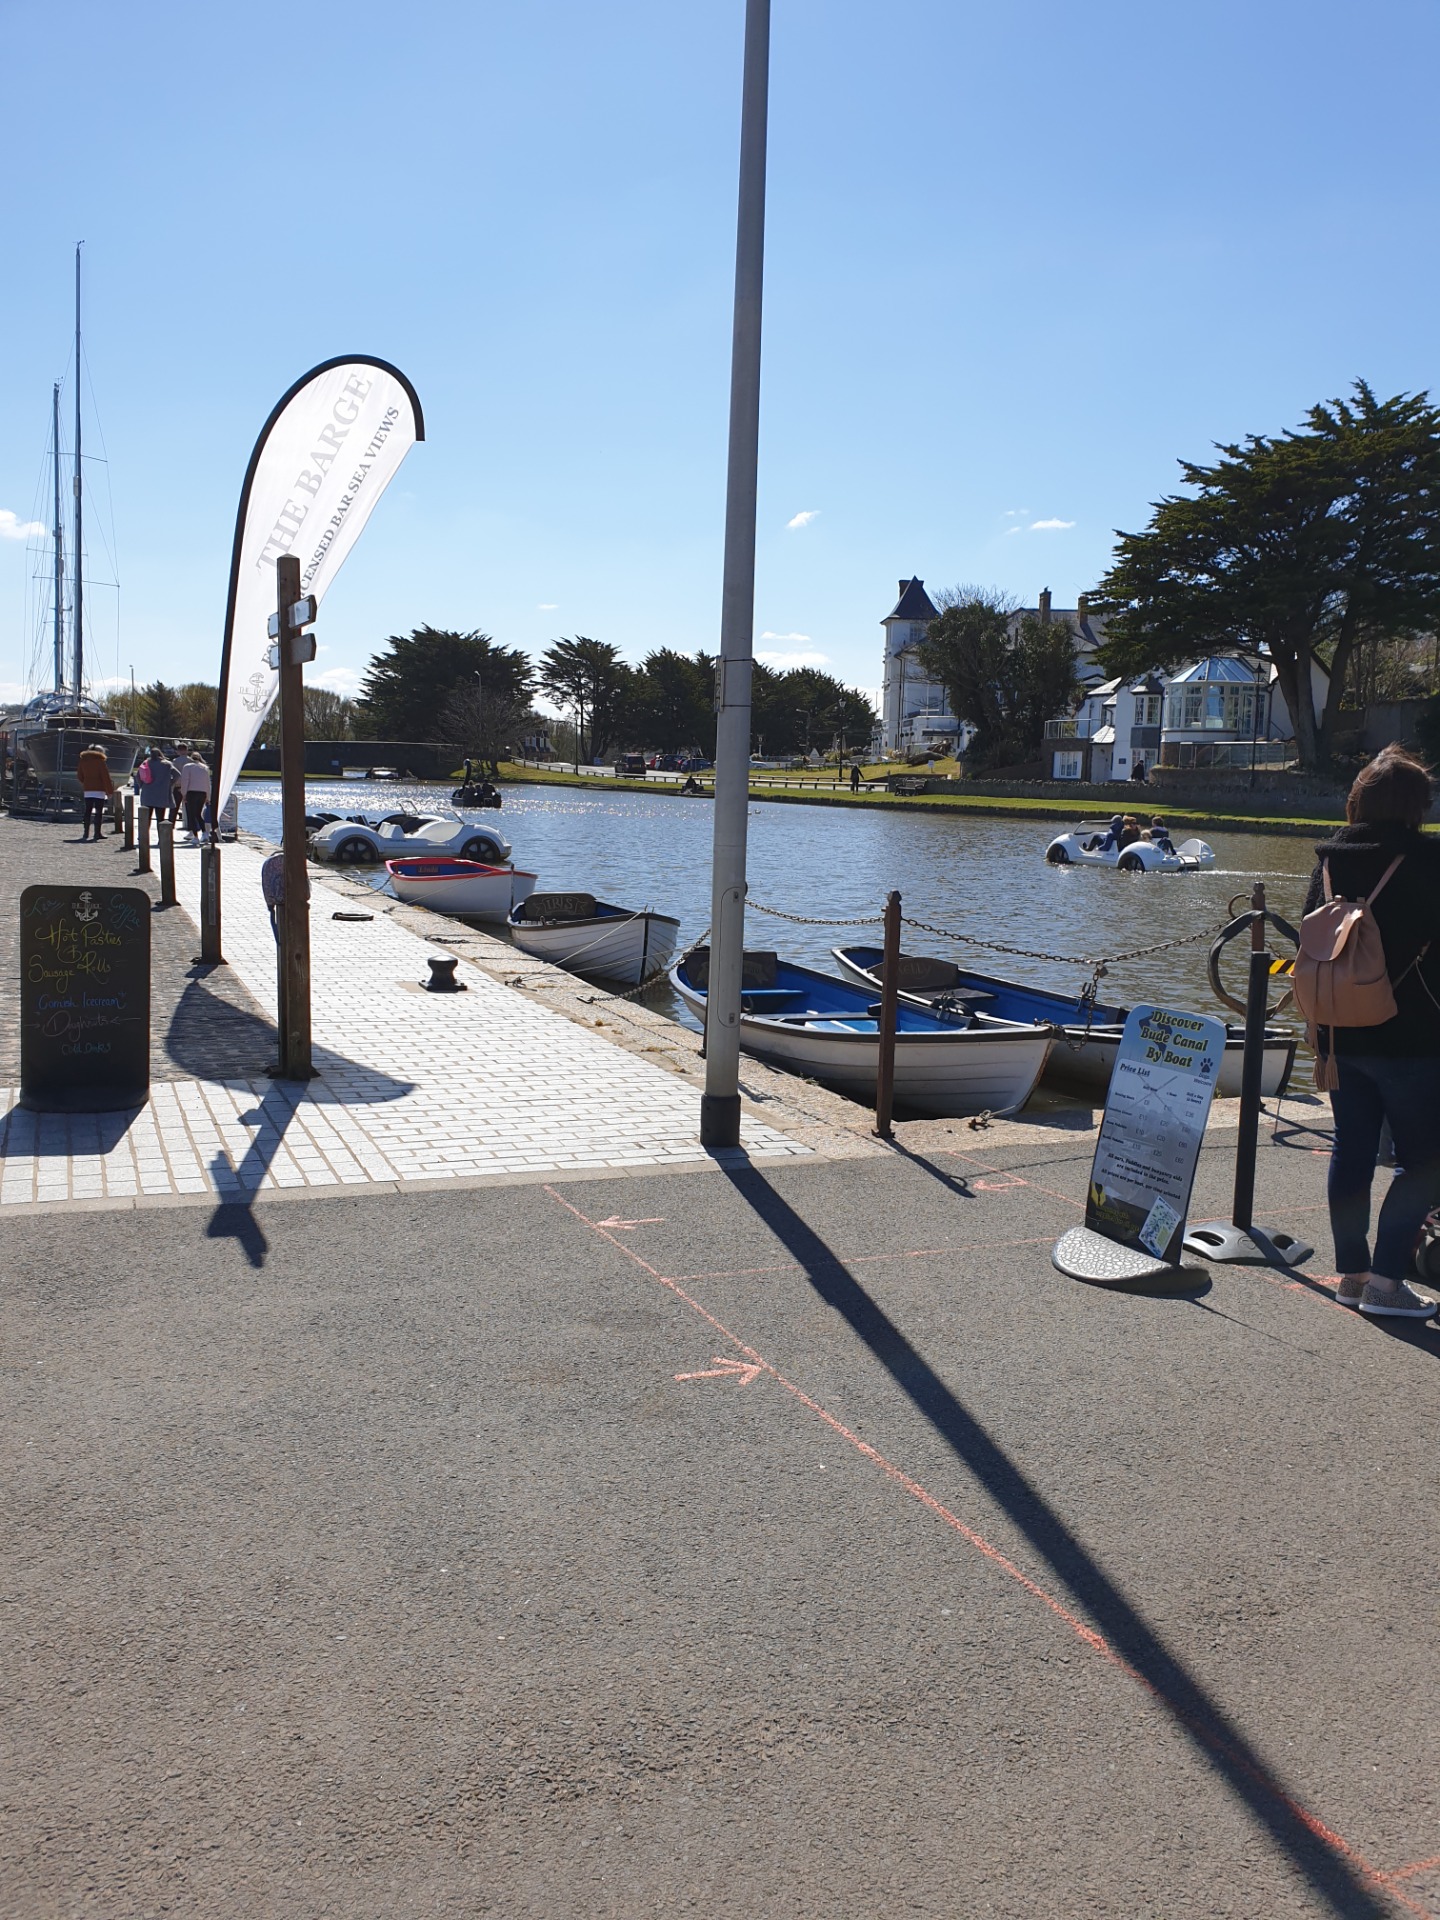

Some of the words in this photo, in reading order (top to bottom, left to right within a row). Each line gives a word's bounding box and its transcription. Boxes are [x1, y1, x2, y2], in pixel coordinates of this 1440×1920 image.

[256, 498, 309, 576] THE
[294, 373, 373, 499] BARGE
[331, 494, 354, 527] BAR
[348, 463, 371, 494] SEA
[364, 406, 399, 458] VIEWS
[546, 896, 573, 910] IRIS
[35, 918, 78, 950] Hot
[28, 954, 76, 993] Sausage
[1151, 1011, 1204, 1031] Discover
[1140, 1026, 1171, 1043] Bude
[1172, 1033, 1209, 1052] Canal
[1120, 1063, 1136, 1073] Price
[1137, 1066, 1151, 1077] List
[1145, 1046, 1162, 1063] By
[1163, 1050, 1193, 1068] Boat
